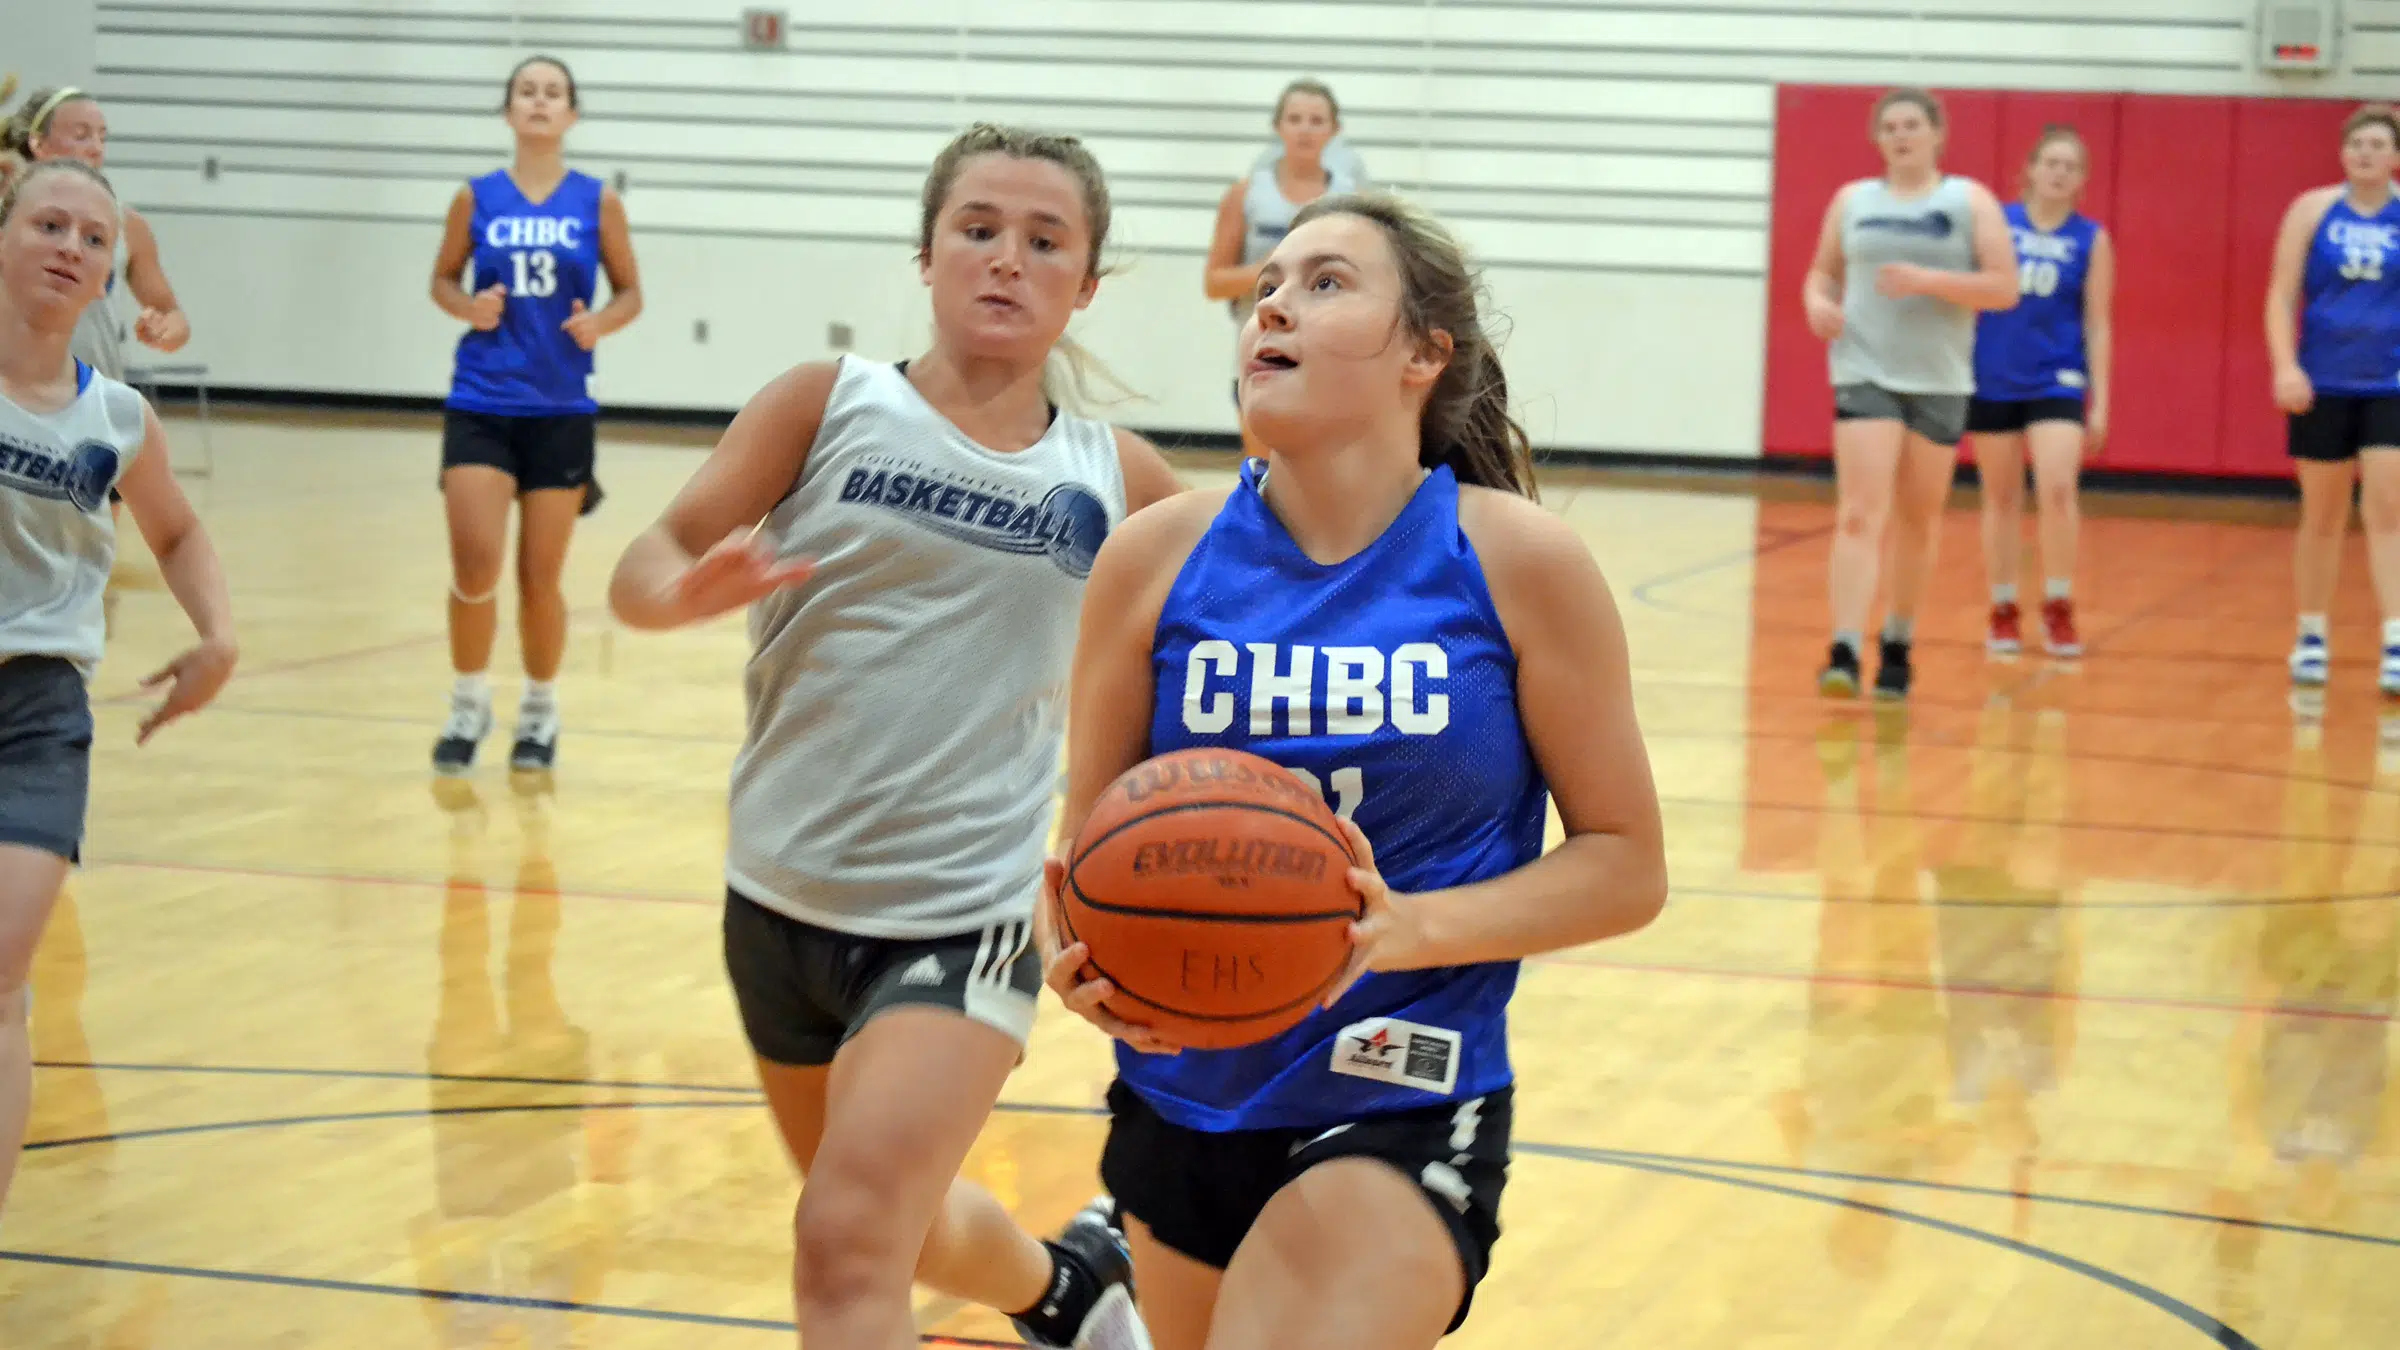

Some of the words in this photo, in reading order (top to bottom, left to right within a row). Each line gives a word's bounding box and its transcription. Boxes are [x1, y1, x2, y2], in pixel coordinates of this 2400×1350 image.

[486, 215, 582, 249] CHBC
[510, 250, 557, 297] 13
[838, 466, 1077, 549] BASKETBALL
[1182, 639, 1449, 736] CHBC
